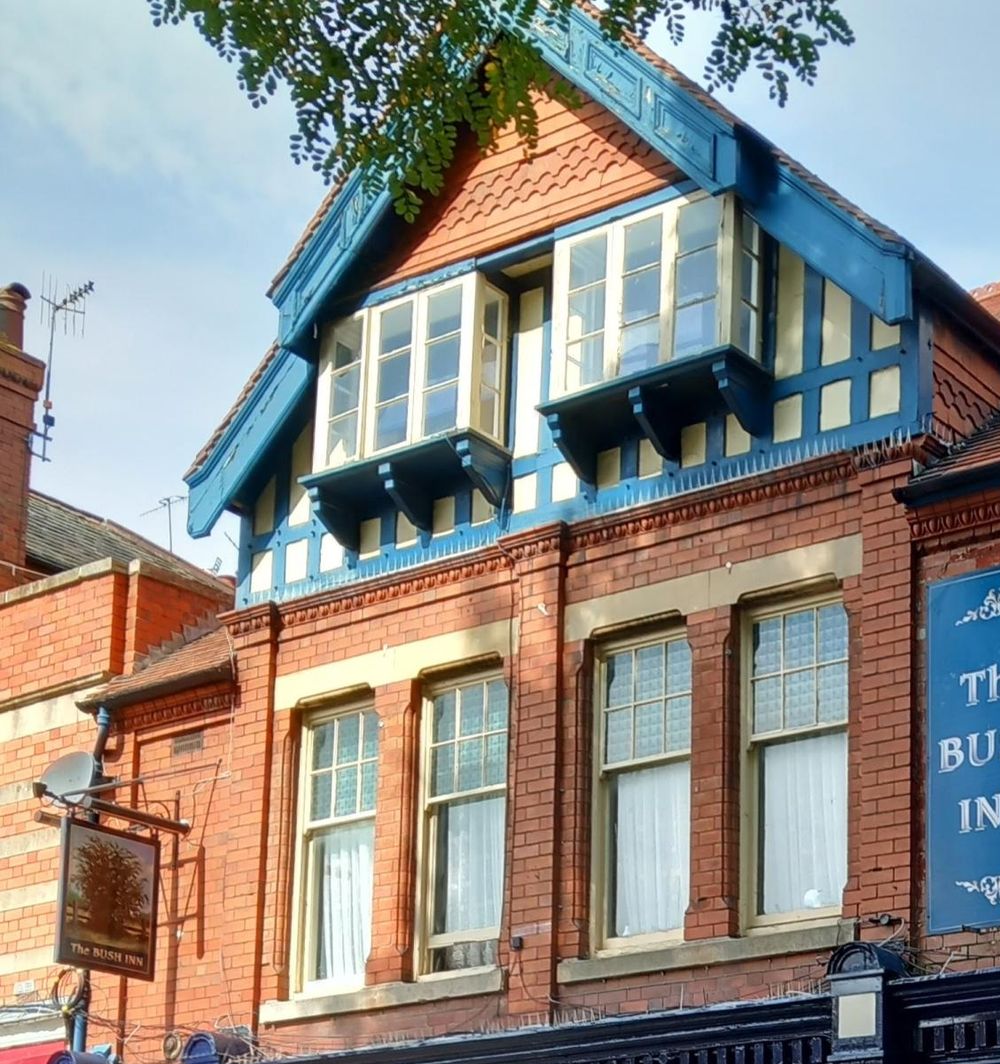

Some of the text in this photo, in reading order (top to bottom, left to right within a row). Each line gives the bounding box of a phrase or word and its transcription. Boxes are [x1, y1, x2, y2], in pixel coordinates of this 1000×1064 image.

[70, 942, 144, 966] The BUSH INN
